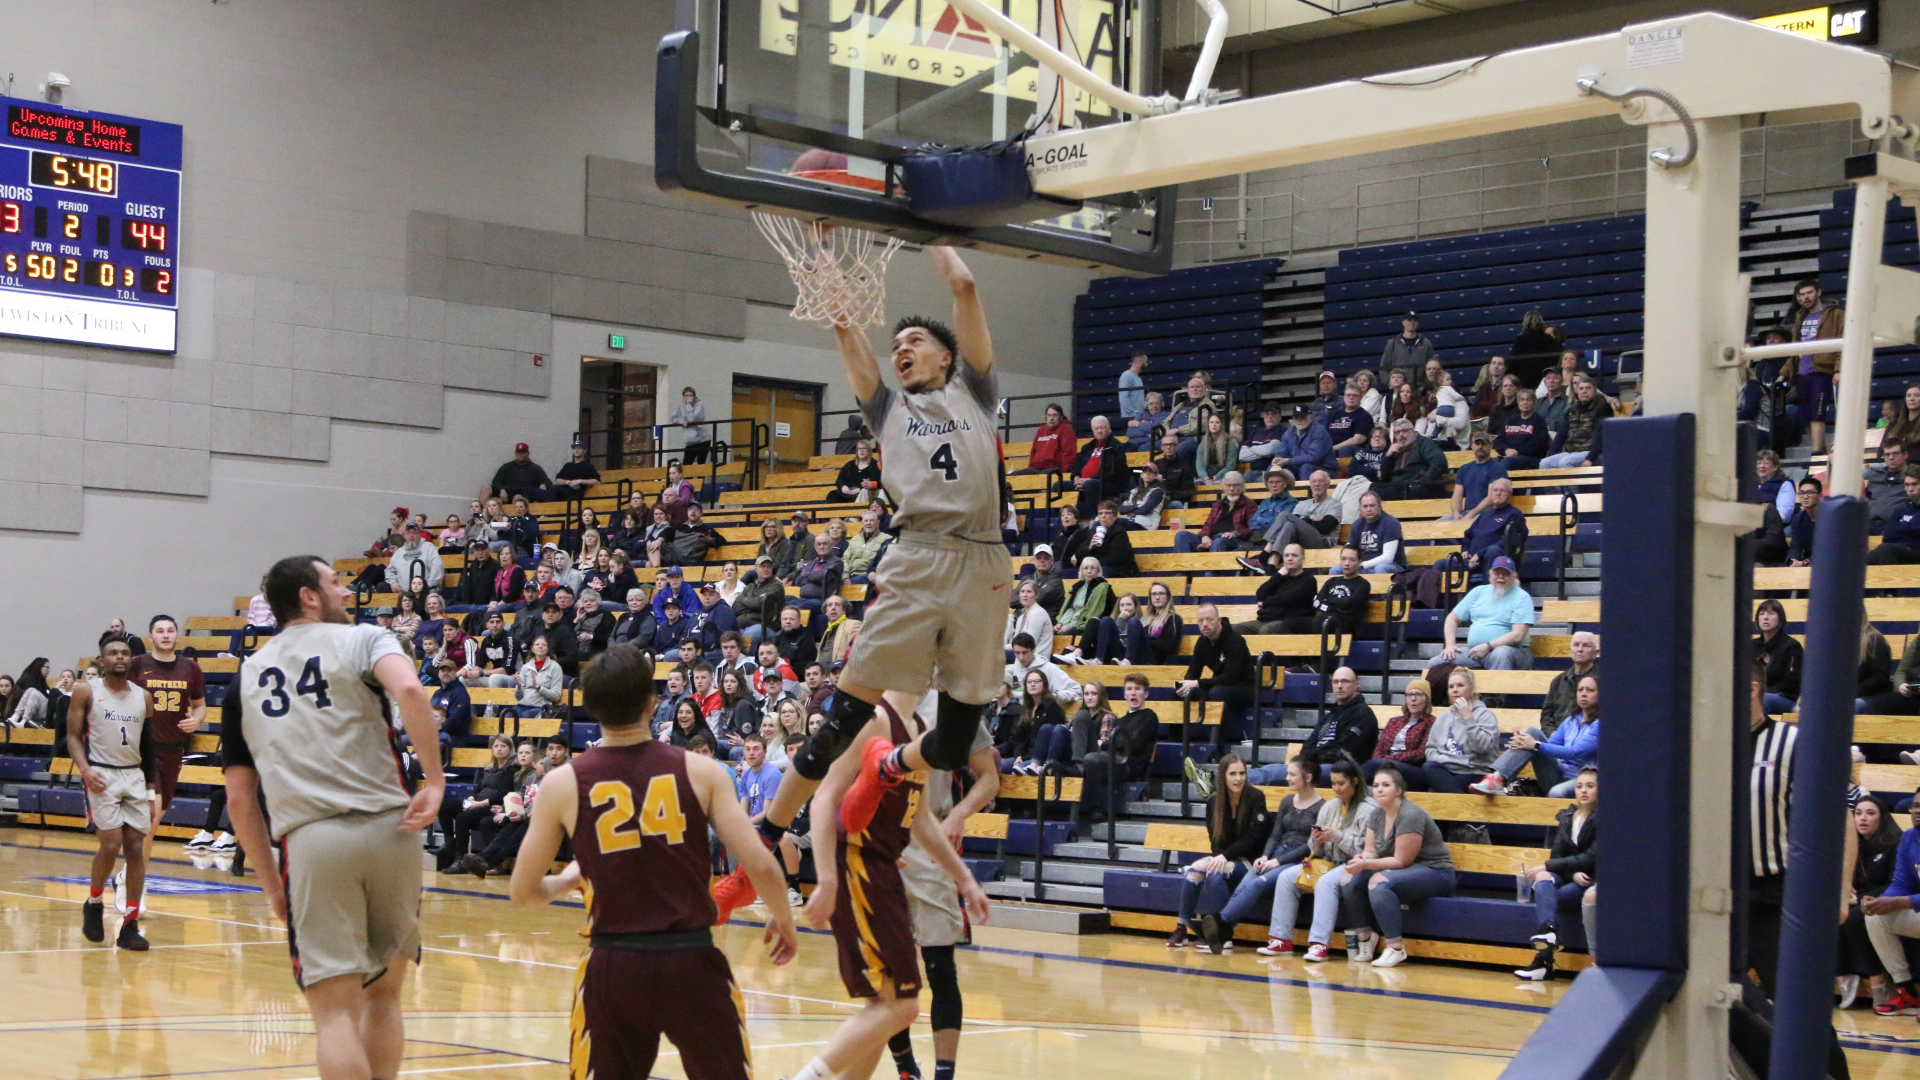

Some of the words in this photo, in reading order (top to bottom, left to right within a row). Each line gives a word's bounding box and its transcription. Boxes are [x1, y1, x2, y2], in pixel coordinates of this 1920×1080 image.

[1831, 10, 1867, 37] CAT
[1628, 28, 1683, 45] DANGER
[20, 108, 85, 131] Upcoming
[92, 119, 127, 138] Home
[11, 121, 58, 142] Games
[66, 130, 76, 144] &
[83, 132, 133, 153] Events
[52, 156, 114, 193] 5:48
[1061, 160, 1088, 170] SYSTEMS
[58, 200, 89, 213] PERIOD
[126, 202, 165, 220] GUEST
[64, 214, 80, 239] 2
[131, 222, 166, 251] 44
[31, 241, 52, 252] PLYR
[60, 244, 82, 256] FOUL
[93, 249, 109, 260] PTS
[26, 254, 57, 280] 50
[63, 259, 79, 283] 2
[144, 255, 171, 268] FOULS
[0, 275, 24, 288] T.O.L.
[100, 263, 115, 288] 0
[123, 268, 135, 287] 3
[156, 271, 171, 293] 2
[117, 289, 140, 301] T.O.L.
[78, 312, 148, 335] TRIBUNE
[612, 335, 625, 348] EXIT
[1587, 349, 1599, 369] J
[997, 398, 1008, 414] K
[652, 426, 660, 440] L
[905, 417, 973, 438] Warriors
[930, 441, 960, 483] 4
[146, 679, 188, 690] NORTHERN
[258, 655, 333, 718] 34
[153, 690, 181, 712] 32
[104, 708, 140, 724] Warriors
[120, 726, 129, 746] 1
[588, 773, 687, 855] 24
